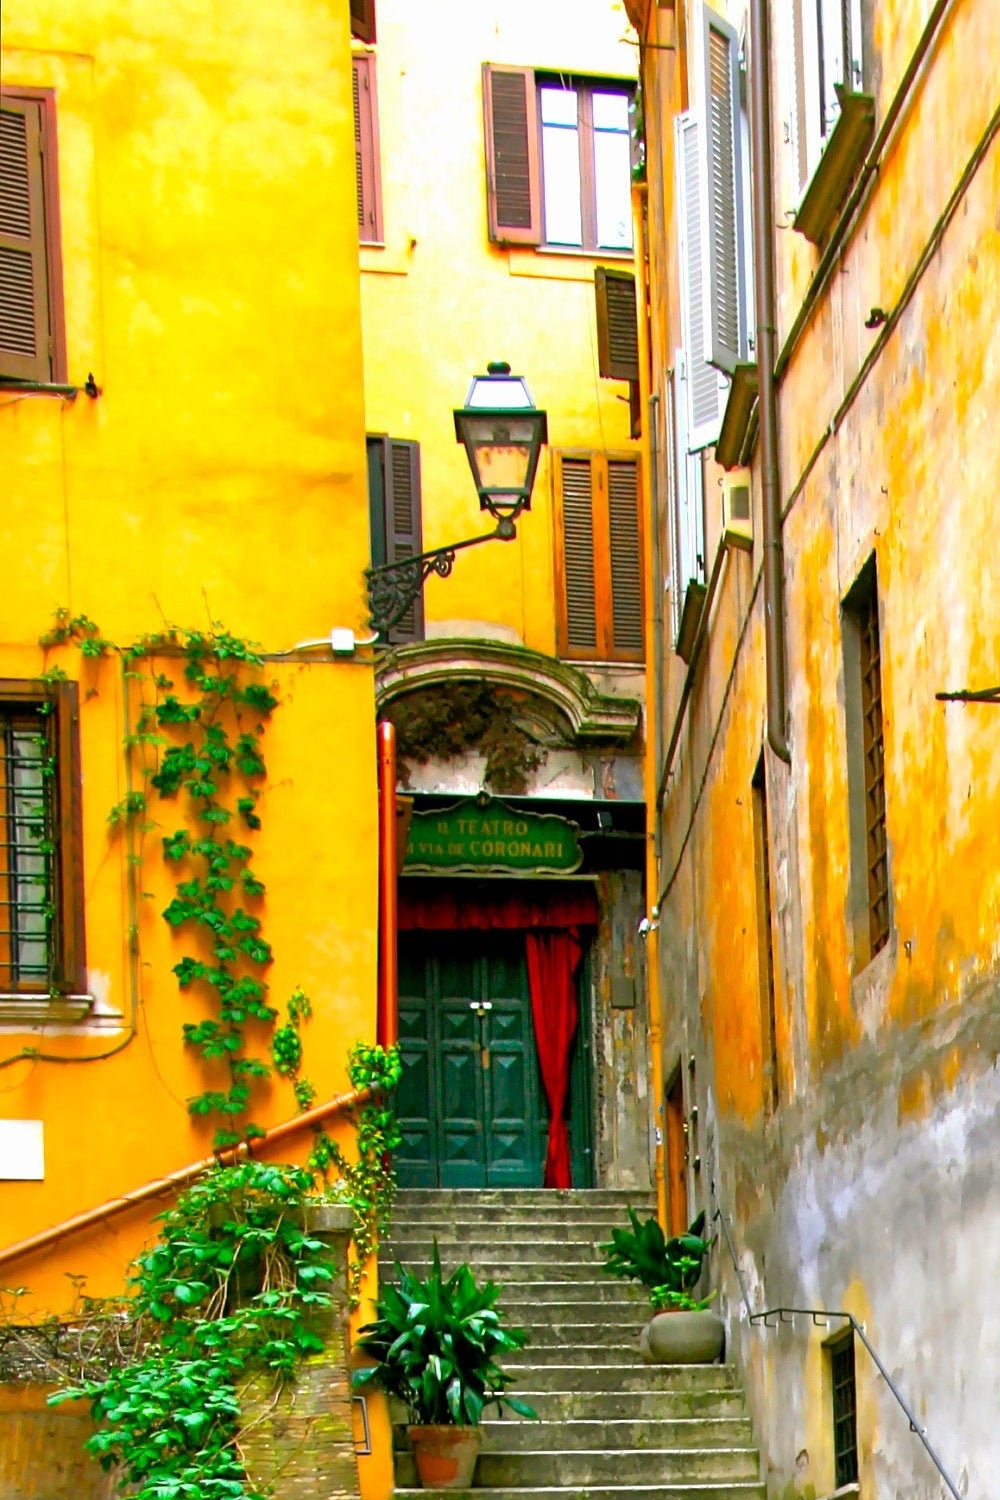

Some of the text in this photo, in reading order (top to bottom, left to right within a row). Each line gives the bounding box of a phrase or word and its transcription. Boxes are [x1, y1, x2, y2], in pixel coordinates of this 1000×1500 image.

[457, 818, 528, 836] TEATRO
[419, 843, 443, 855] VIA
[470, 841, 563, 858] CORONARI
